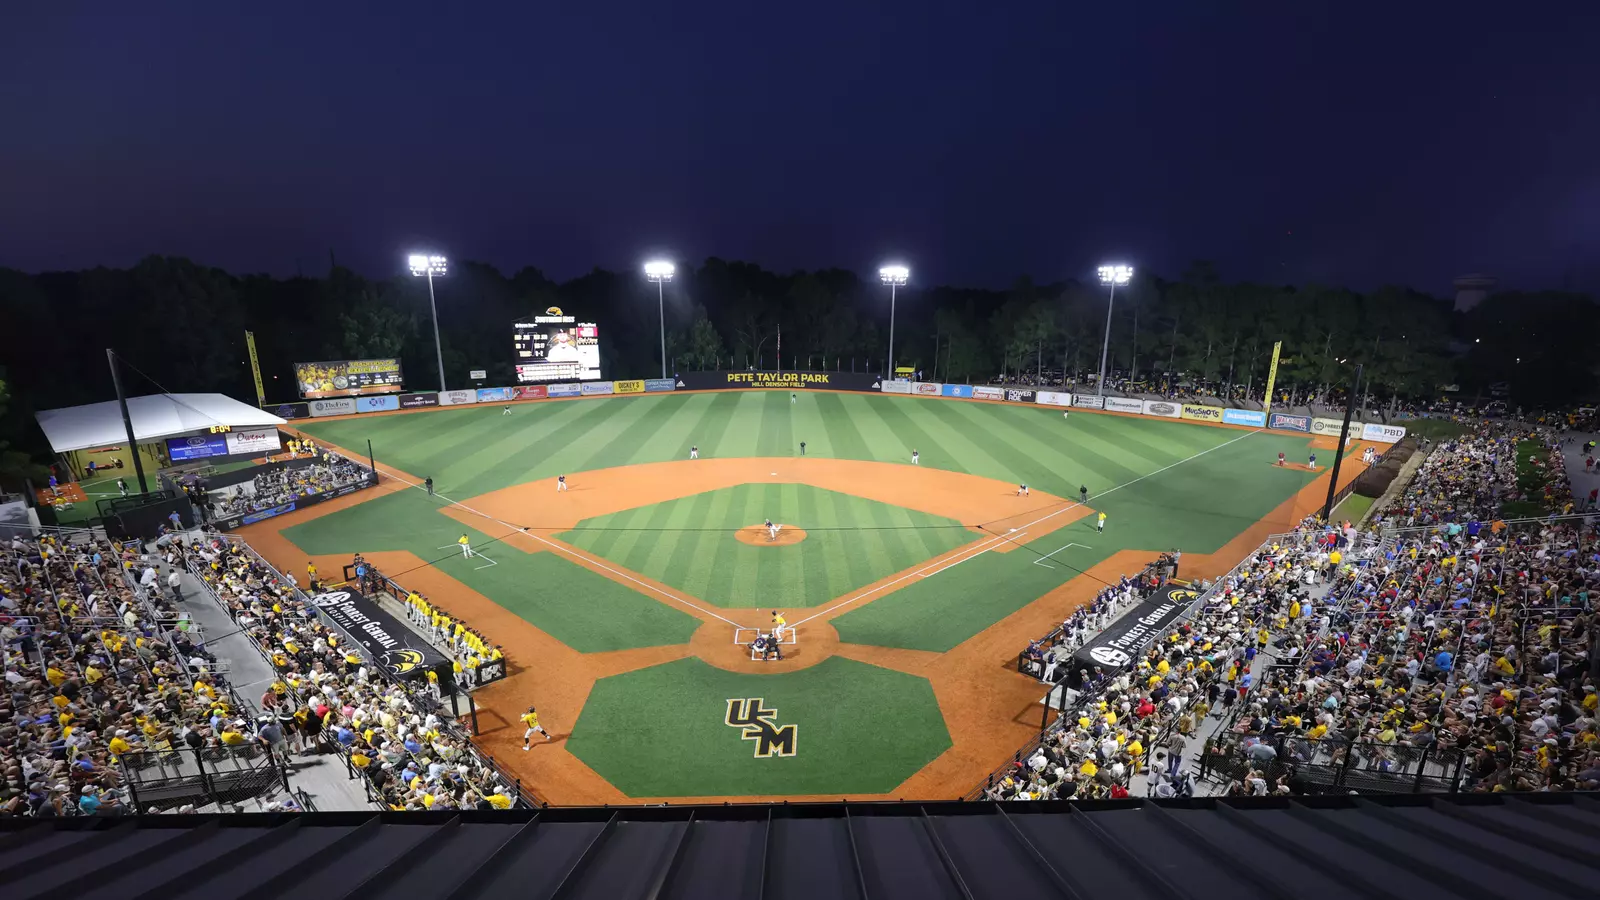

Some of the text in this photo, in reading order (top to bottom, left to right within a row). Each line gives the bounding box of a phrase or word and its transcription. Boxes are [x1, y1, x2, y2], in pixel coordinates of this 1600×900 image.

[727, 373, 829, 383] PETE TAYLOR PARK
[1008, 389, 1032, 397] POWER
[210, 425, 231, 433] 8:04
[1383, 428, 1403, 437] PBD
[325, 607, 355, 629] HOSPITAL
[336, 600, 398, 649] FORREST GENERAL
[1108, 603, 1176, 649] FORREST GENERAL
[724, 697, 798, 758] USM
[1151, 763, 1159, 774] 10
